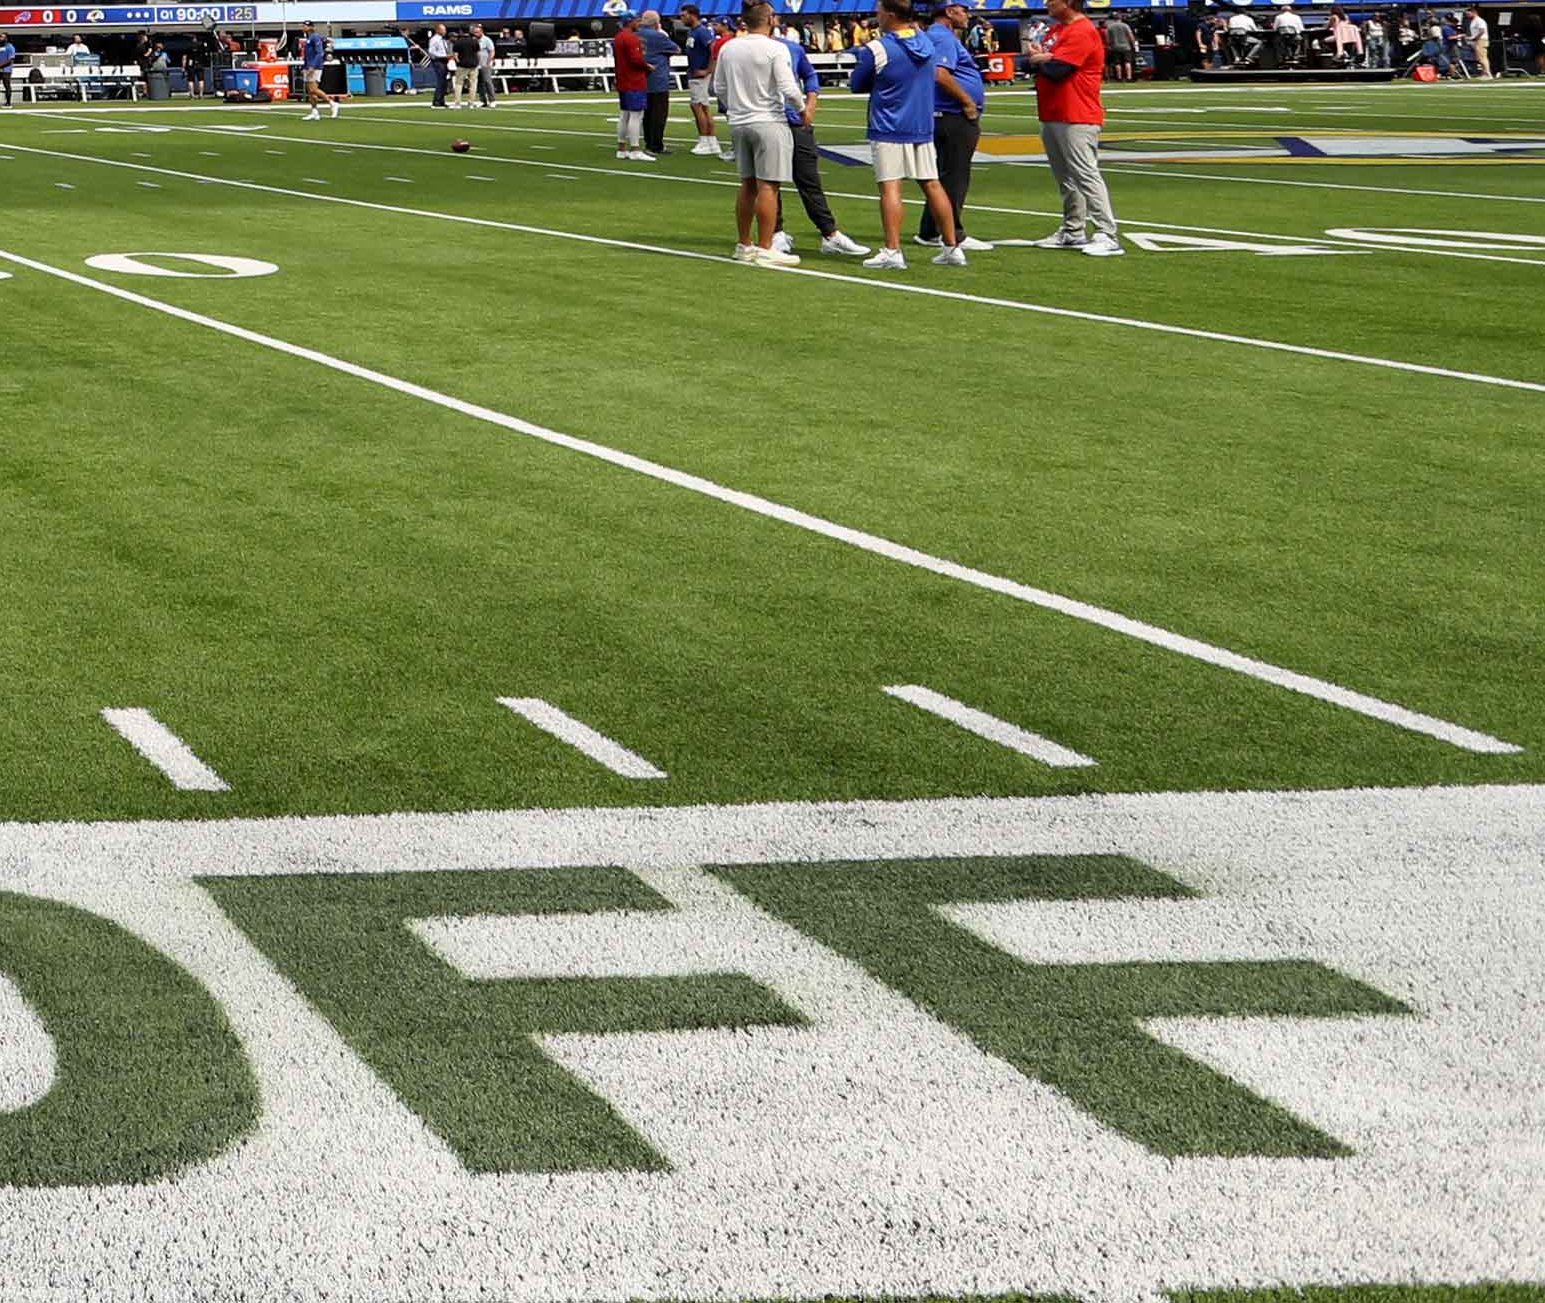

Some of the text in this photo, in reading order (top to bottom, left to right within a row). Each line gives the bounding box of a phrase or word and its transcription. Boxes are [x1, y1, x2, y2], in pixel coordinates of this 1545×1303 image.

[423, 4, 473, 15] RAMS
[43, 10, 54, 23] 0
[66, 10, 77, 23] 0
[989, 58, 1004, 73] G
[274, 89, 282, 98] G
